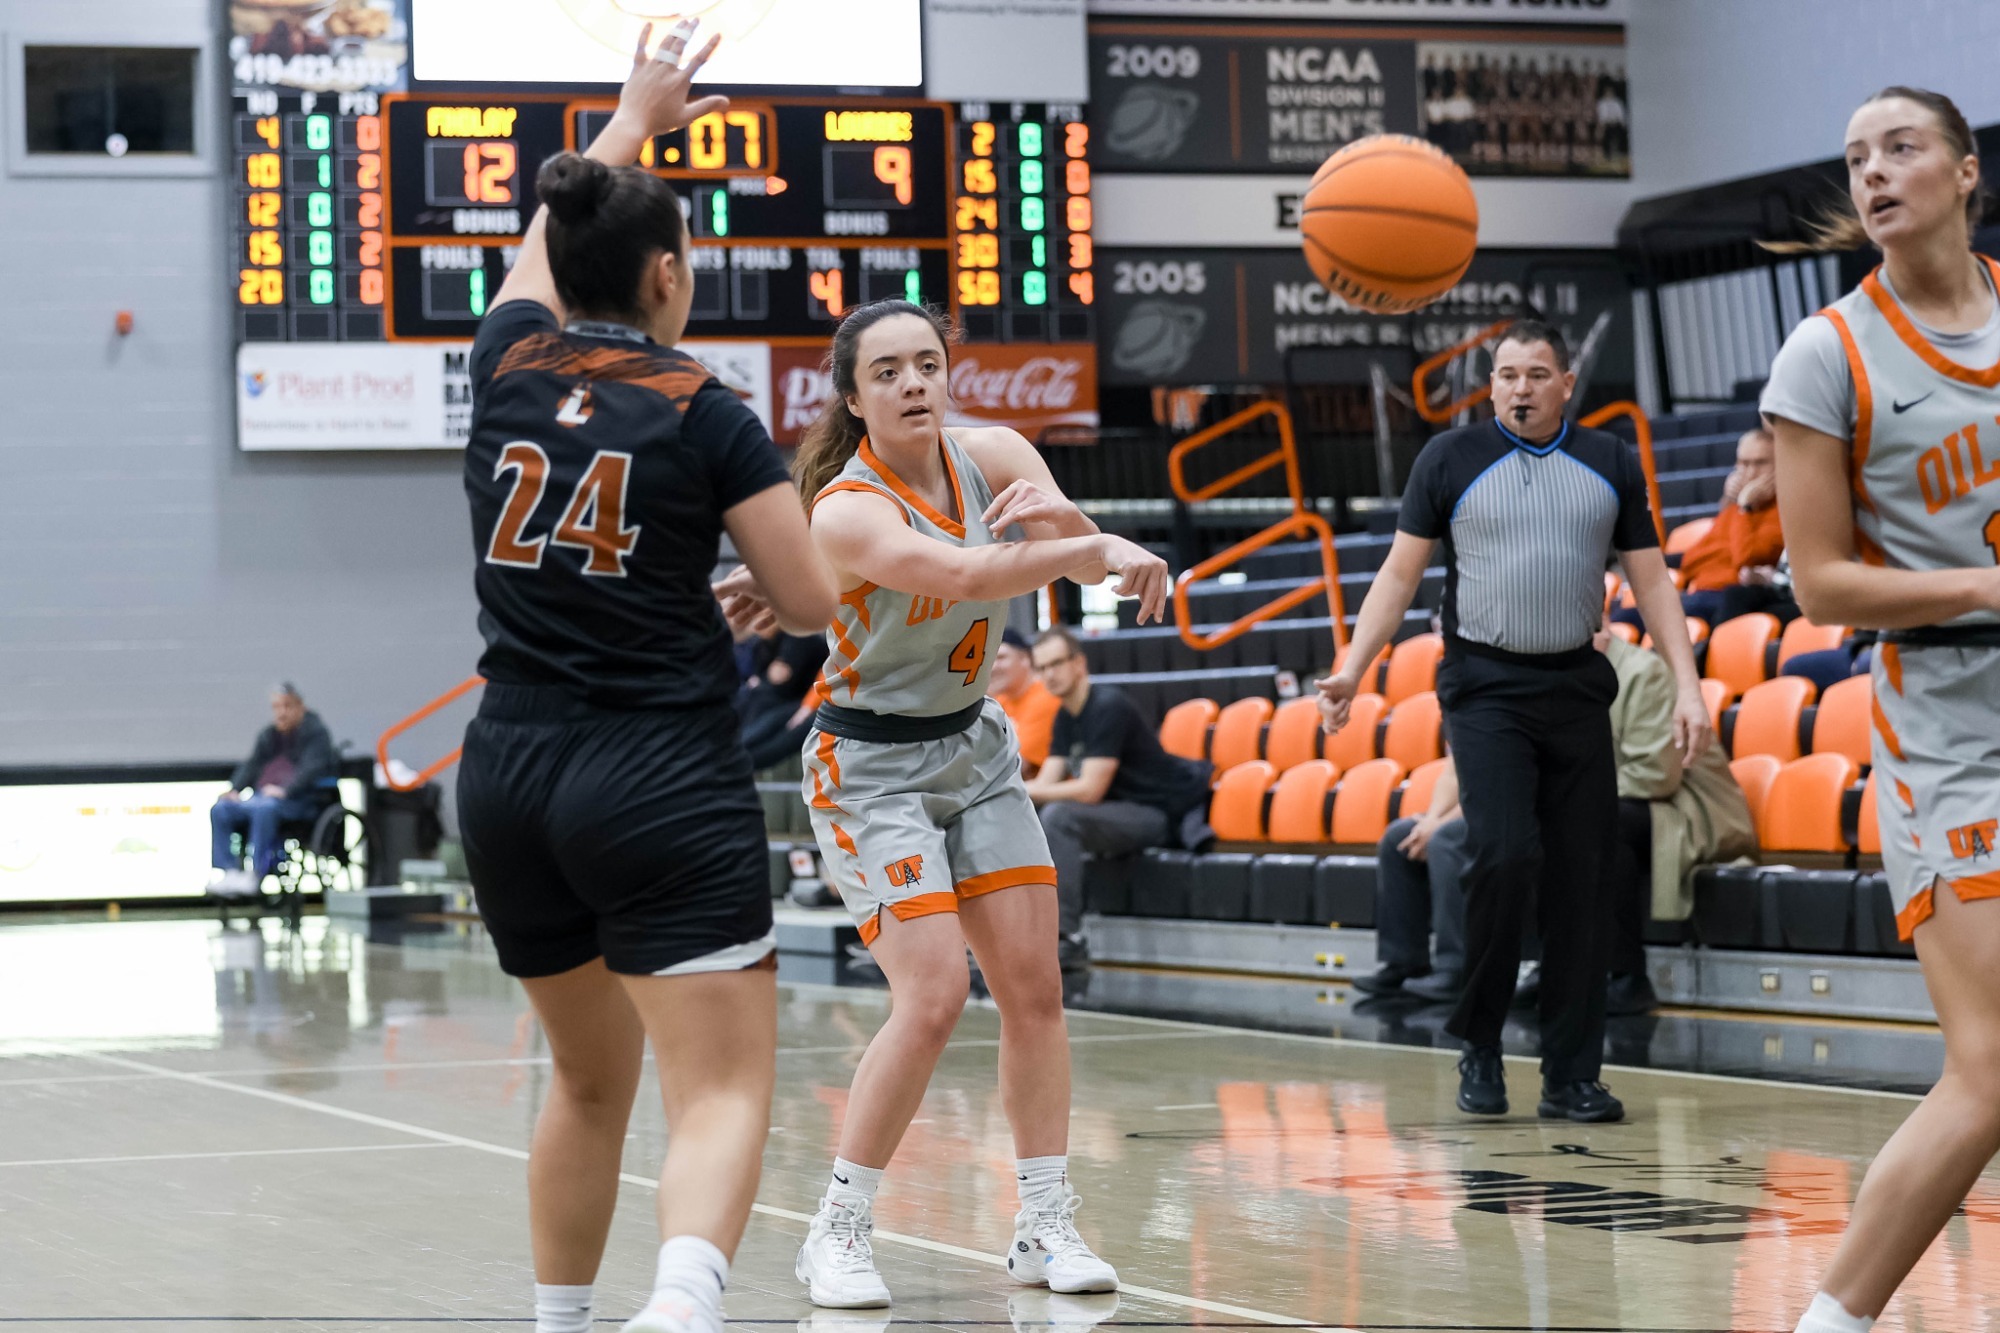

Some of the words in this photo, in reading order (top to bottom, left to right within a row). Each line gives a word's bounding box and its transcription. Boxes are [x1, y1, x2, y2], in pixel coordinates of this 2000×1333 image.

[1106, 45, 1200, 78] 2009
[1267, 48, 1382, 82] NCAA
[1266, 85, 1366, 107] DIVISION
[256, 116, 280, 149] 4
[972, 122, 995, 157] 2
[1065, 123, 1089, 157] 2
[1270, 110, 1384, 142] MEN'S
[317, 154, 331, 188] 1
[357, 154, 382, 189] 2
[464, 143, 516, 203] 12
[873, 146, 912, 205] 9
[357, 192, 382, 227] 2
[712, 189, 728, 237] 1
[358, 231, 383, 266] 2
[1032, 235, 1046, 268] 1
[470, 268, 485, 317] 1
[811, 269, 843, 317] 4
[1069, 271, 1093, 305] 4
[1113, 261, 1206, 294] 2005
[1273, 282, 1360, 314] NCA
[949, 358, 1082, 409] Coca-Cola
[1917, 415, 2000, 516] OIL
[485, 440, 642, 578] 24
[948, 617, 988, 687] 4
